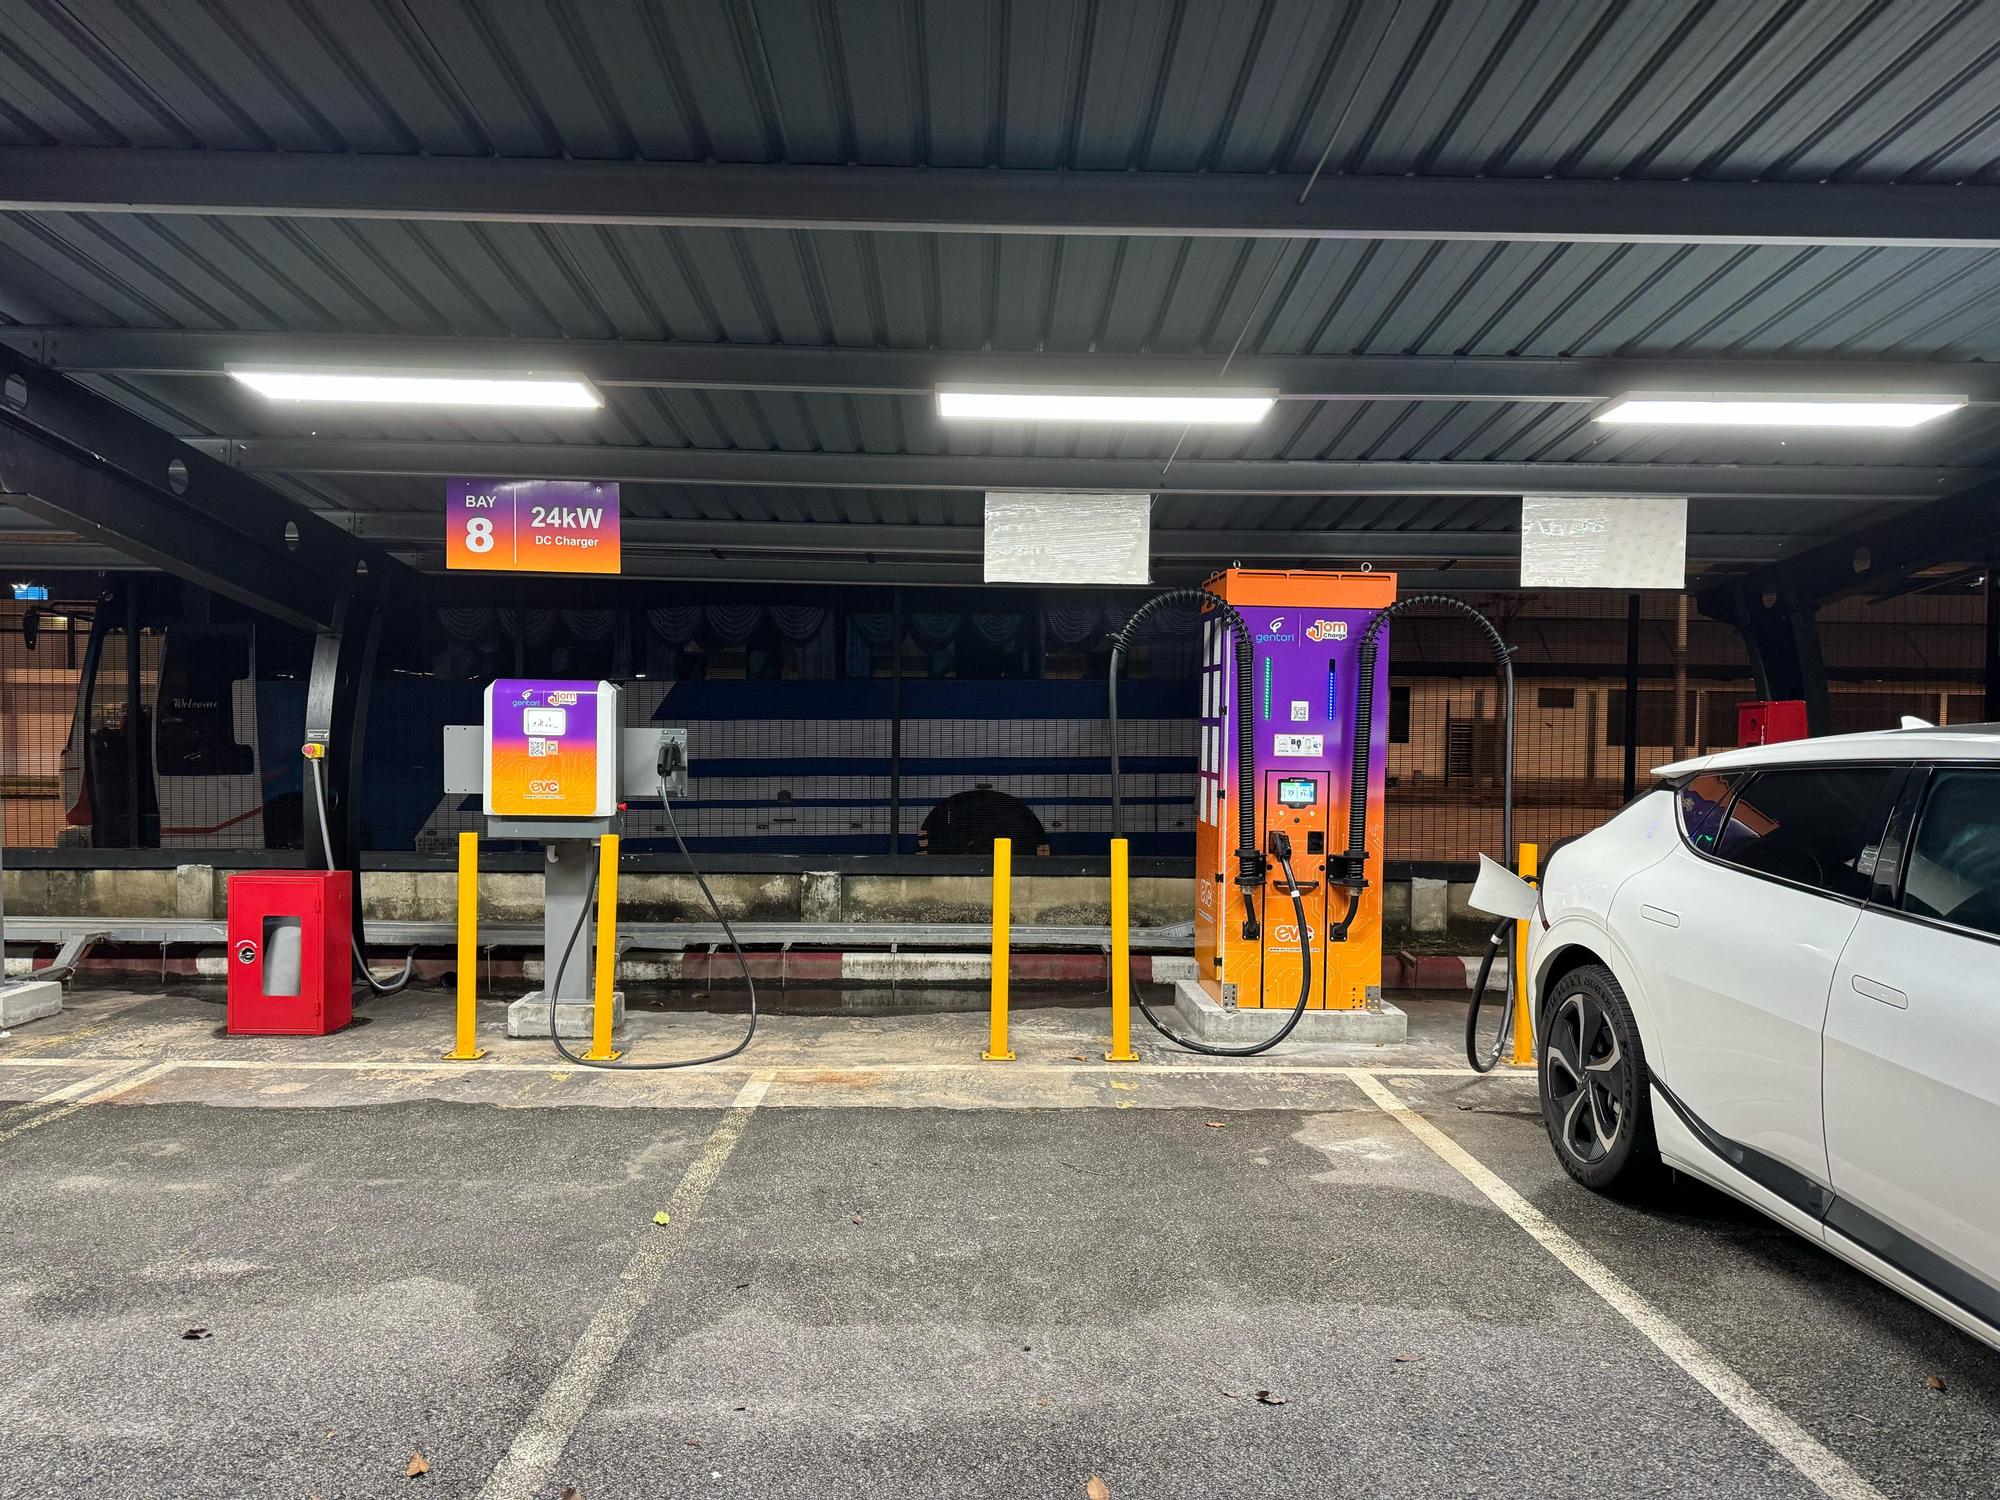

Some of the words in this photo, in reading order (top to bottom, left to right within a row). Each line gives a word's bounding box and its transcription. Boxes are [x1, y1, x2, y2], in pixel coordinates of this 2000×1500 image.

[465, 495, 497, 508] BAY
[531, 506, 603, 529] 24kW
[465, 517, 494, 553] 8
[535, 535, 552, 545] DC
[554, 535, 599, 548] Charger
[1313, 621, 1347, 640] Jom
[1323, 632, 1347, 640] Charge
[1256, 633, 1295, 644] gentari
[173, 698, 218, 708] Welcome
